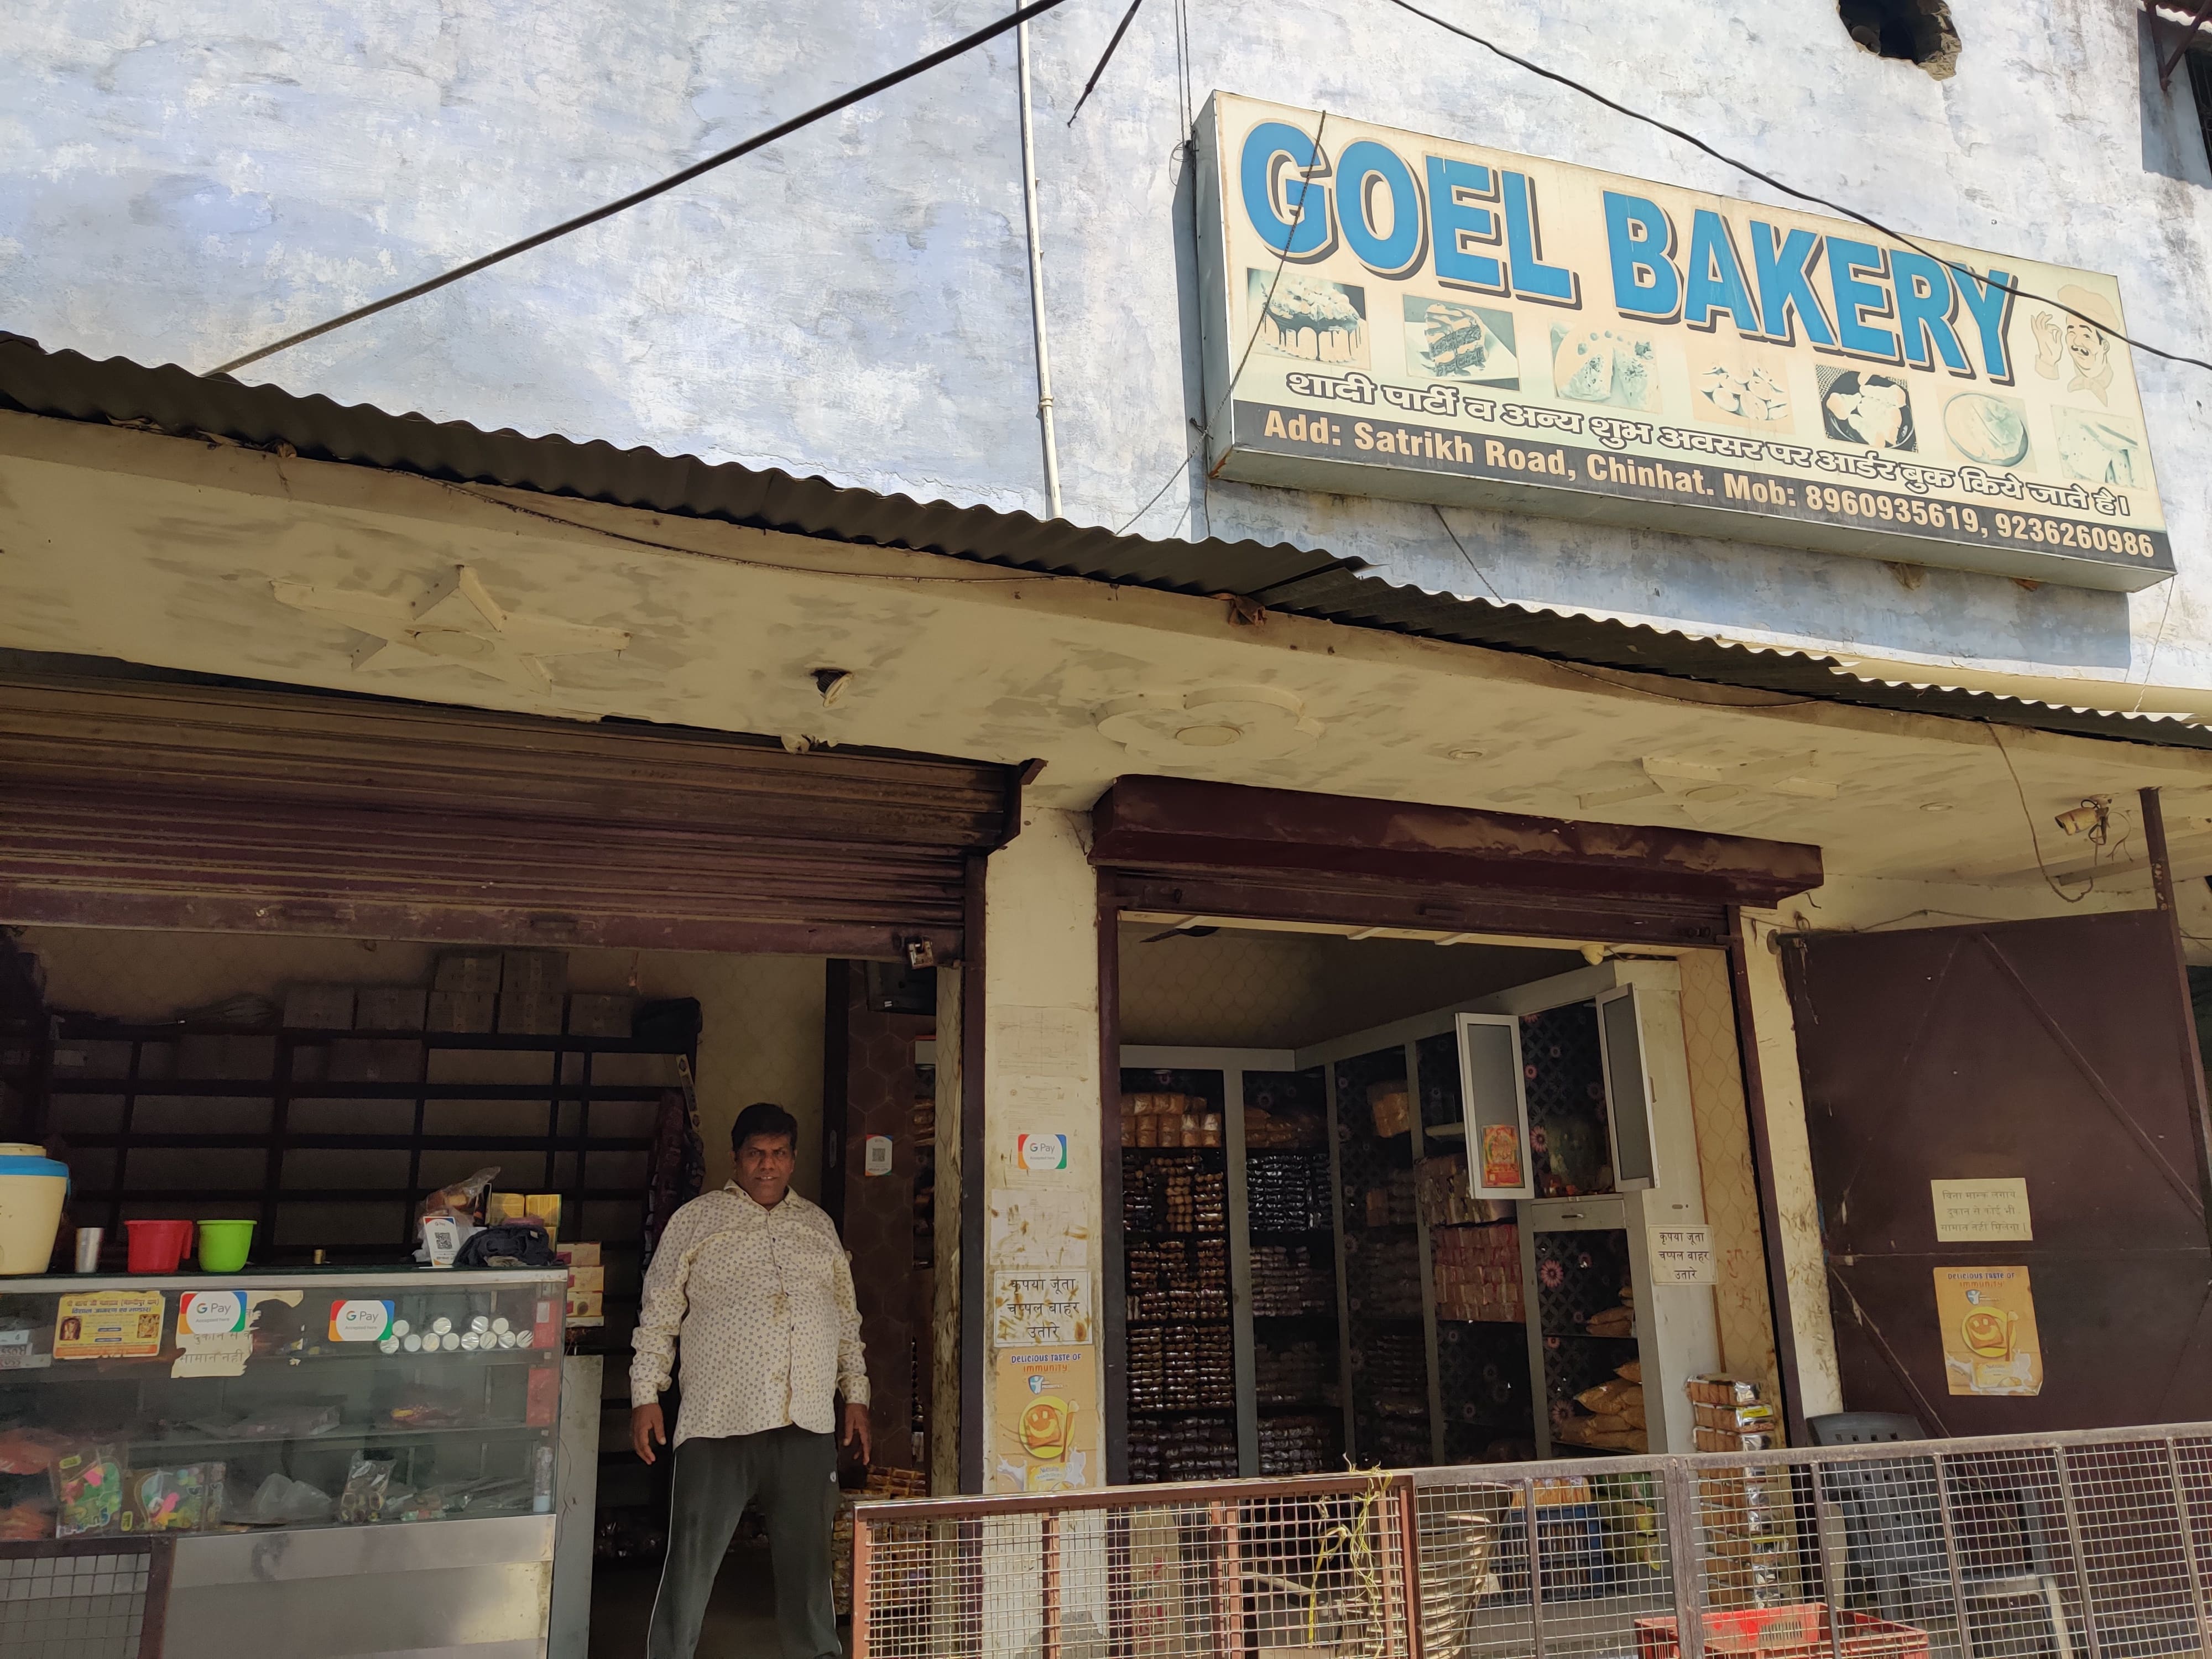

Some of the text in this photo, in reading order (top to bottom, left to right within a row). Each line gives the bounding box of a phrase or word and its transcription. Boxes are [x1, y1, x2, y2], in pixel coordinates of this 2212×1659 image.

[1240, 120, 2017, 385] GOEL BAKERY
[1286, 372, 1377, 405] शादी
[1381, 384, 1459, 416] पार्टी
[1463, 397, 1496, 422] व
[1500, 403, 1584, 434] अन्य
[1589, 416, 1653, 450] शुभ
[1658, 427, 1764, 461] अवसर
[1766, 441, 1813, 467] पर
[1815, 450, 1896, 481] आर्डर
[1898, 463, 1954, 494] बुक
[1959, 465, 2024, 500] किये
[2026, 483, 2090, 510] जाते
[1264, 410, 2154, 558] Add: Satrikh Road, Chinhat. Mob: 8960935619, 9236260986
[1030, 1142, 1055, 1154] G Pay
[1659, 1233, 1704, 1245] कृपया जूता
[1658, 1251, 1684, 1261] चप्पल
[1674, 1266, 1697, 1280] उतारे
[1010, 1278, 1076, 1295] कृपया जूता
[197, 1303, 231, 1314] G Pay
[1007, 1302, 1080, 1318] चप्पल बाहर
[346, 1311, 379, 1323] G Pay
